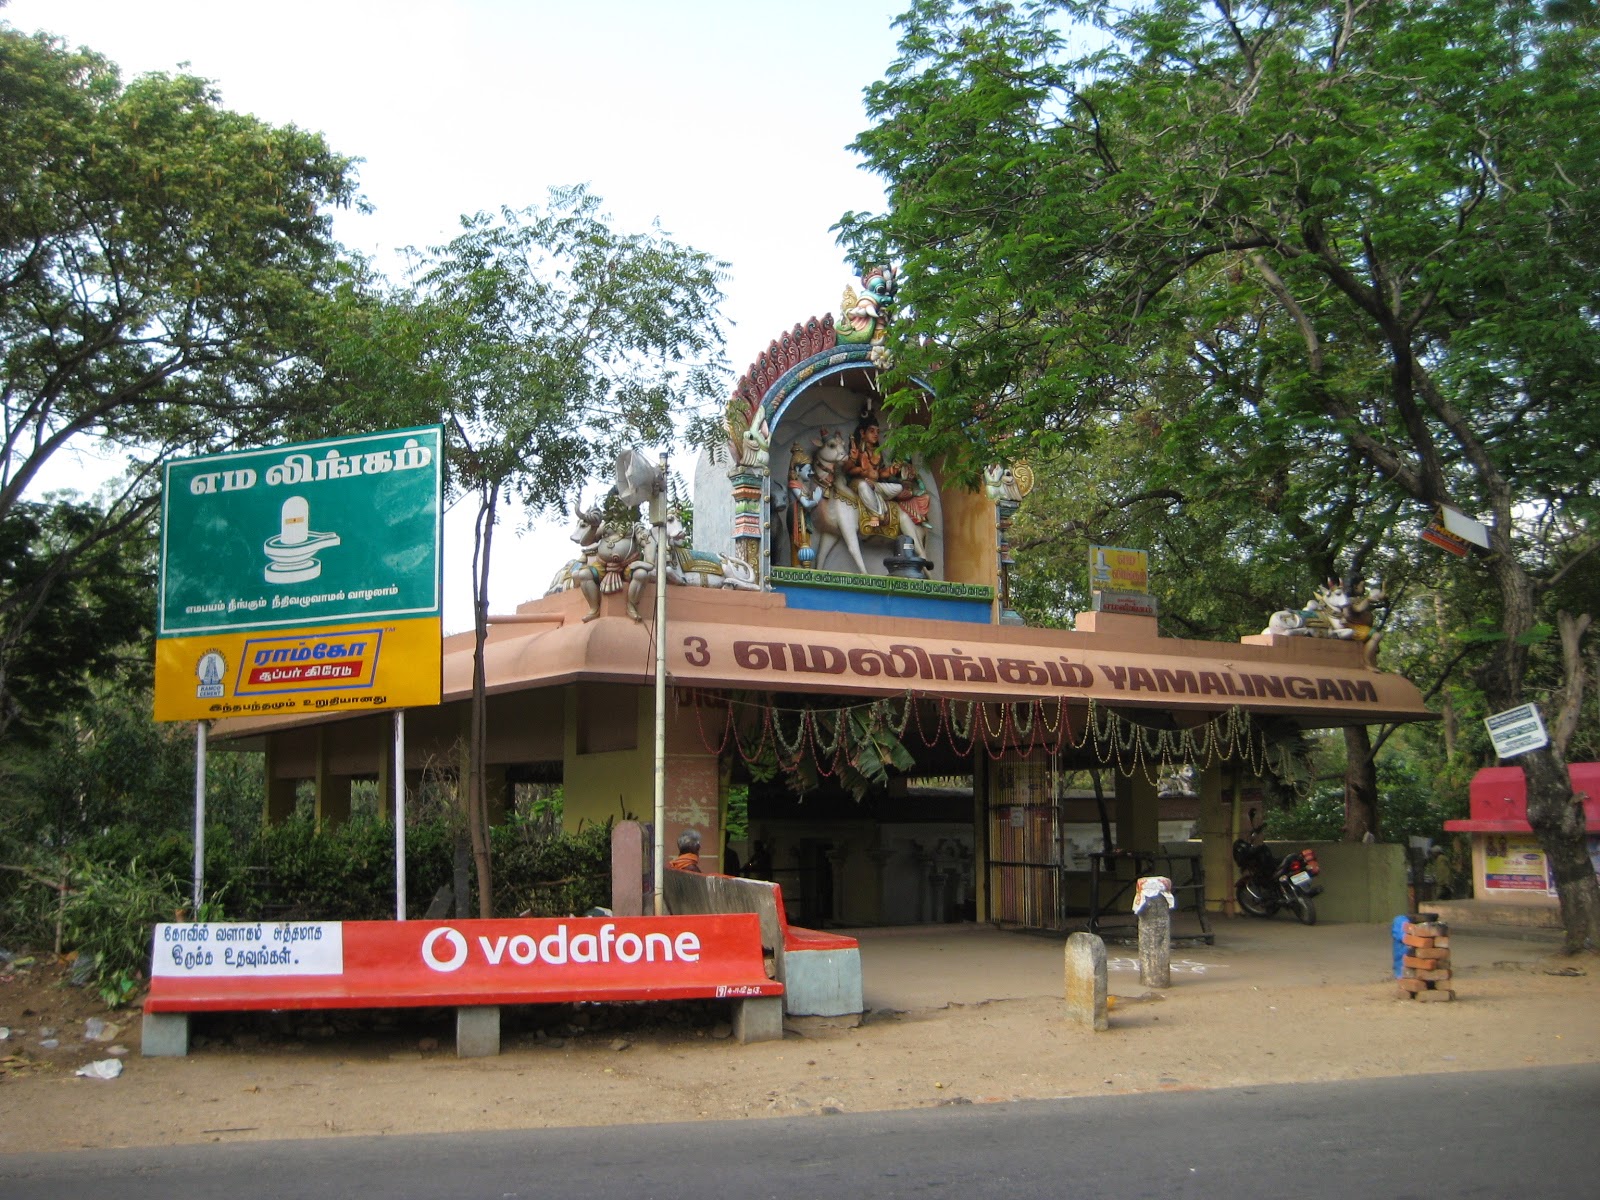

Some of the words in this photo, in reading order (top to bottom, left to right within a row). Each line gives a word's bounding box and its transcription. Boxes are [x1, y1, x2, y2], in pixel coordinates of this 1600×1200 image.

[190, 469, 257, 495] எம
[265, 438, 432, 486] லிங்கம்
[185, 599, 226, 614] எமபயம்
[228, 596, 267, 612] நீங்கும்
[271, 589, 345, 609] நீதிவழுவாமல்
[348, 583, 399, 601] வாழலாம்
[254, 642, 368, 666] ராம்கோ
[259, 667, 302, 682] சூப்பர்
[683, 636, 711, 667] 3
[733, 639, 1094, 688] எமலிங்கம்
[1099, 663, 1379, 702] YAMALINGAM
[164, 923, 209, 942] கோவில்
[215, 924, 262, 942] வளாகம்
[479, 924, 700, 963] vodafone
[172, 944, 214, 970] இருக்க
